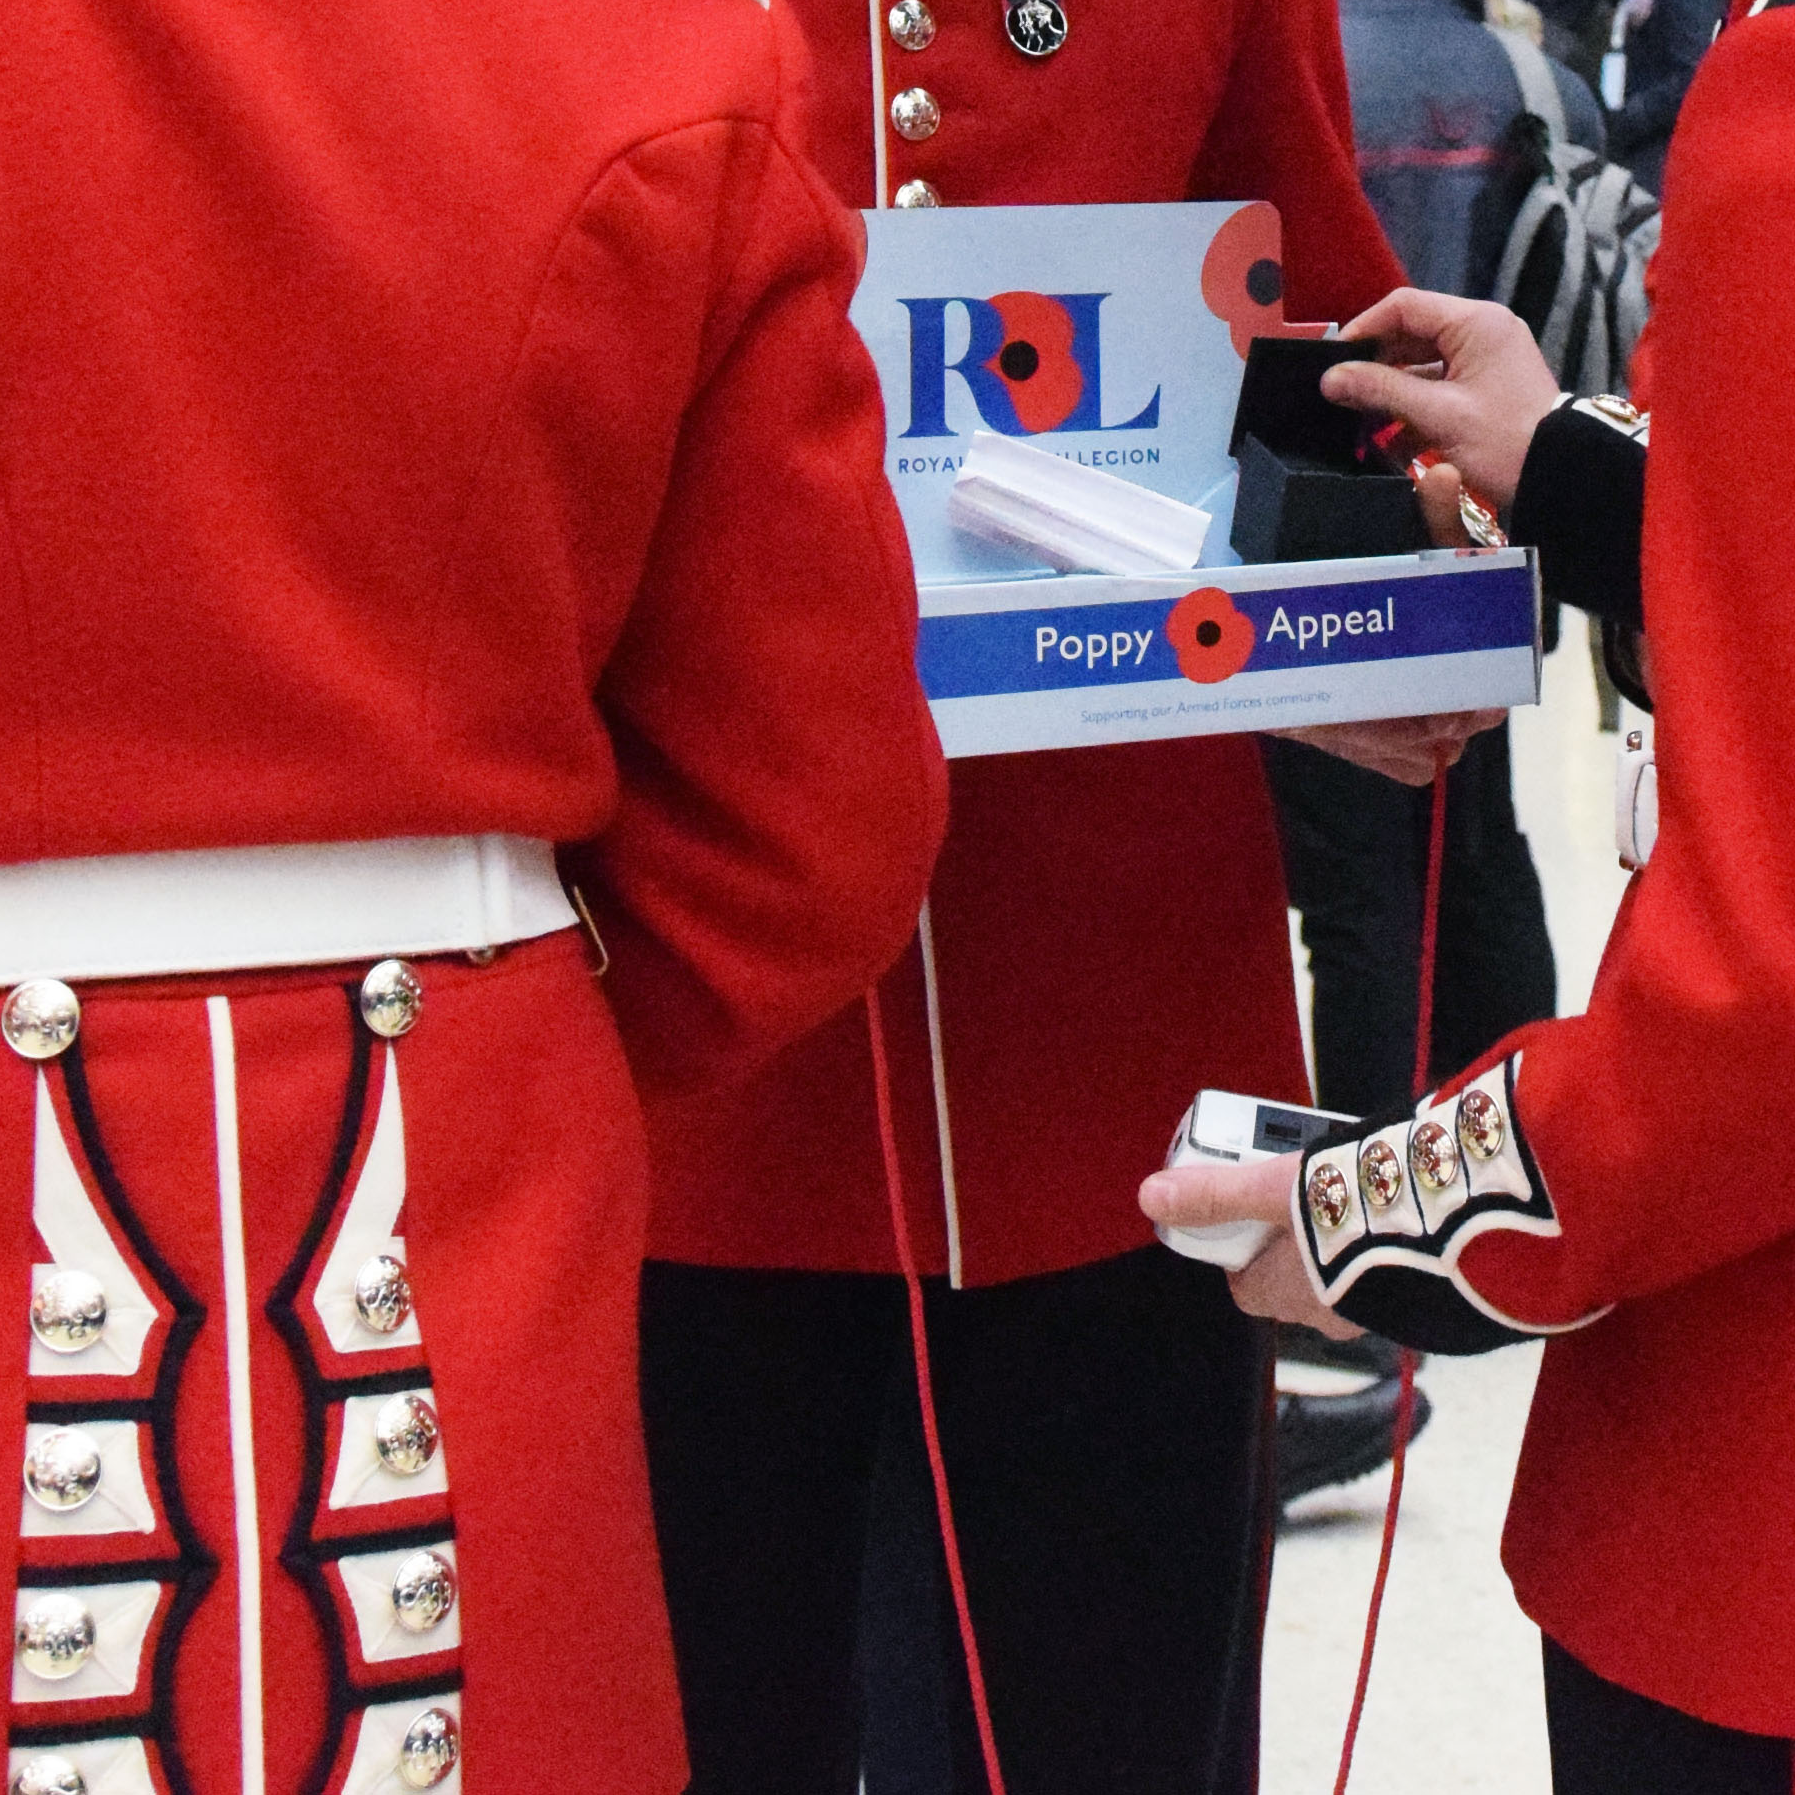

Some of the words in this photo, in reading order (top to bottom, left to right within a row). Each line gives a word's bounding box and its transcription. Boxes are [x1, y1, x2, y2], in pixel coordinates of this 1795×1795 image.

[1078, 448, 1160, 466] LEGION
[1036, 626, 1154, 669] Poppy
[1266, 597, 1395, 650] Appeal
[1081, 709, 1149, 725] Supporting
[1152, 707, 1172, 717] our
[1177, 701, 1220, 714] Armed
[1223, 697, 1262, 711] Forces
[1266, 689, 1333, 707] community
